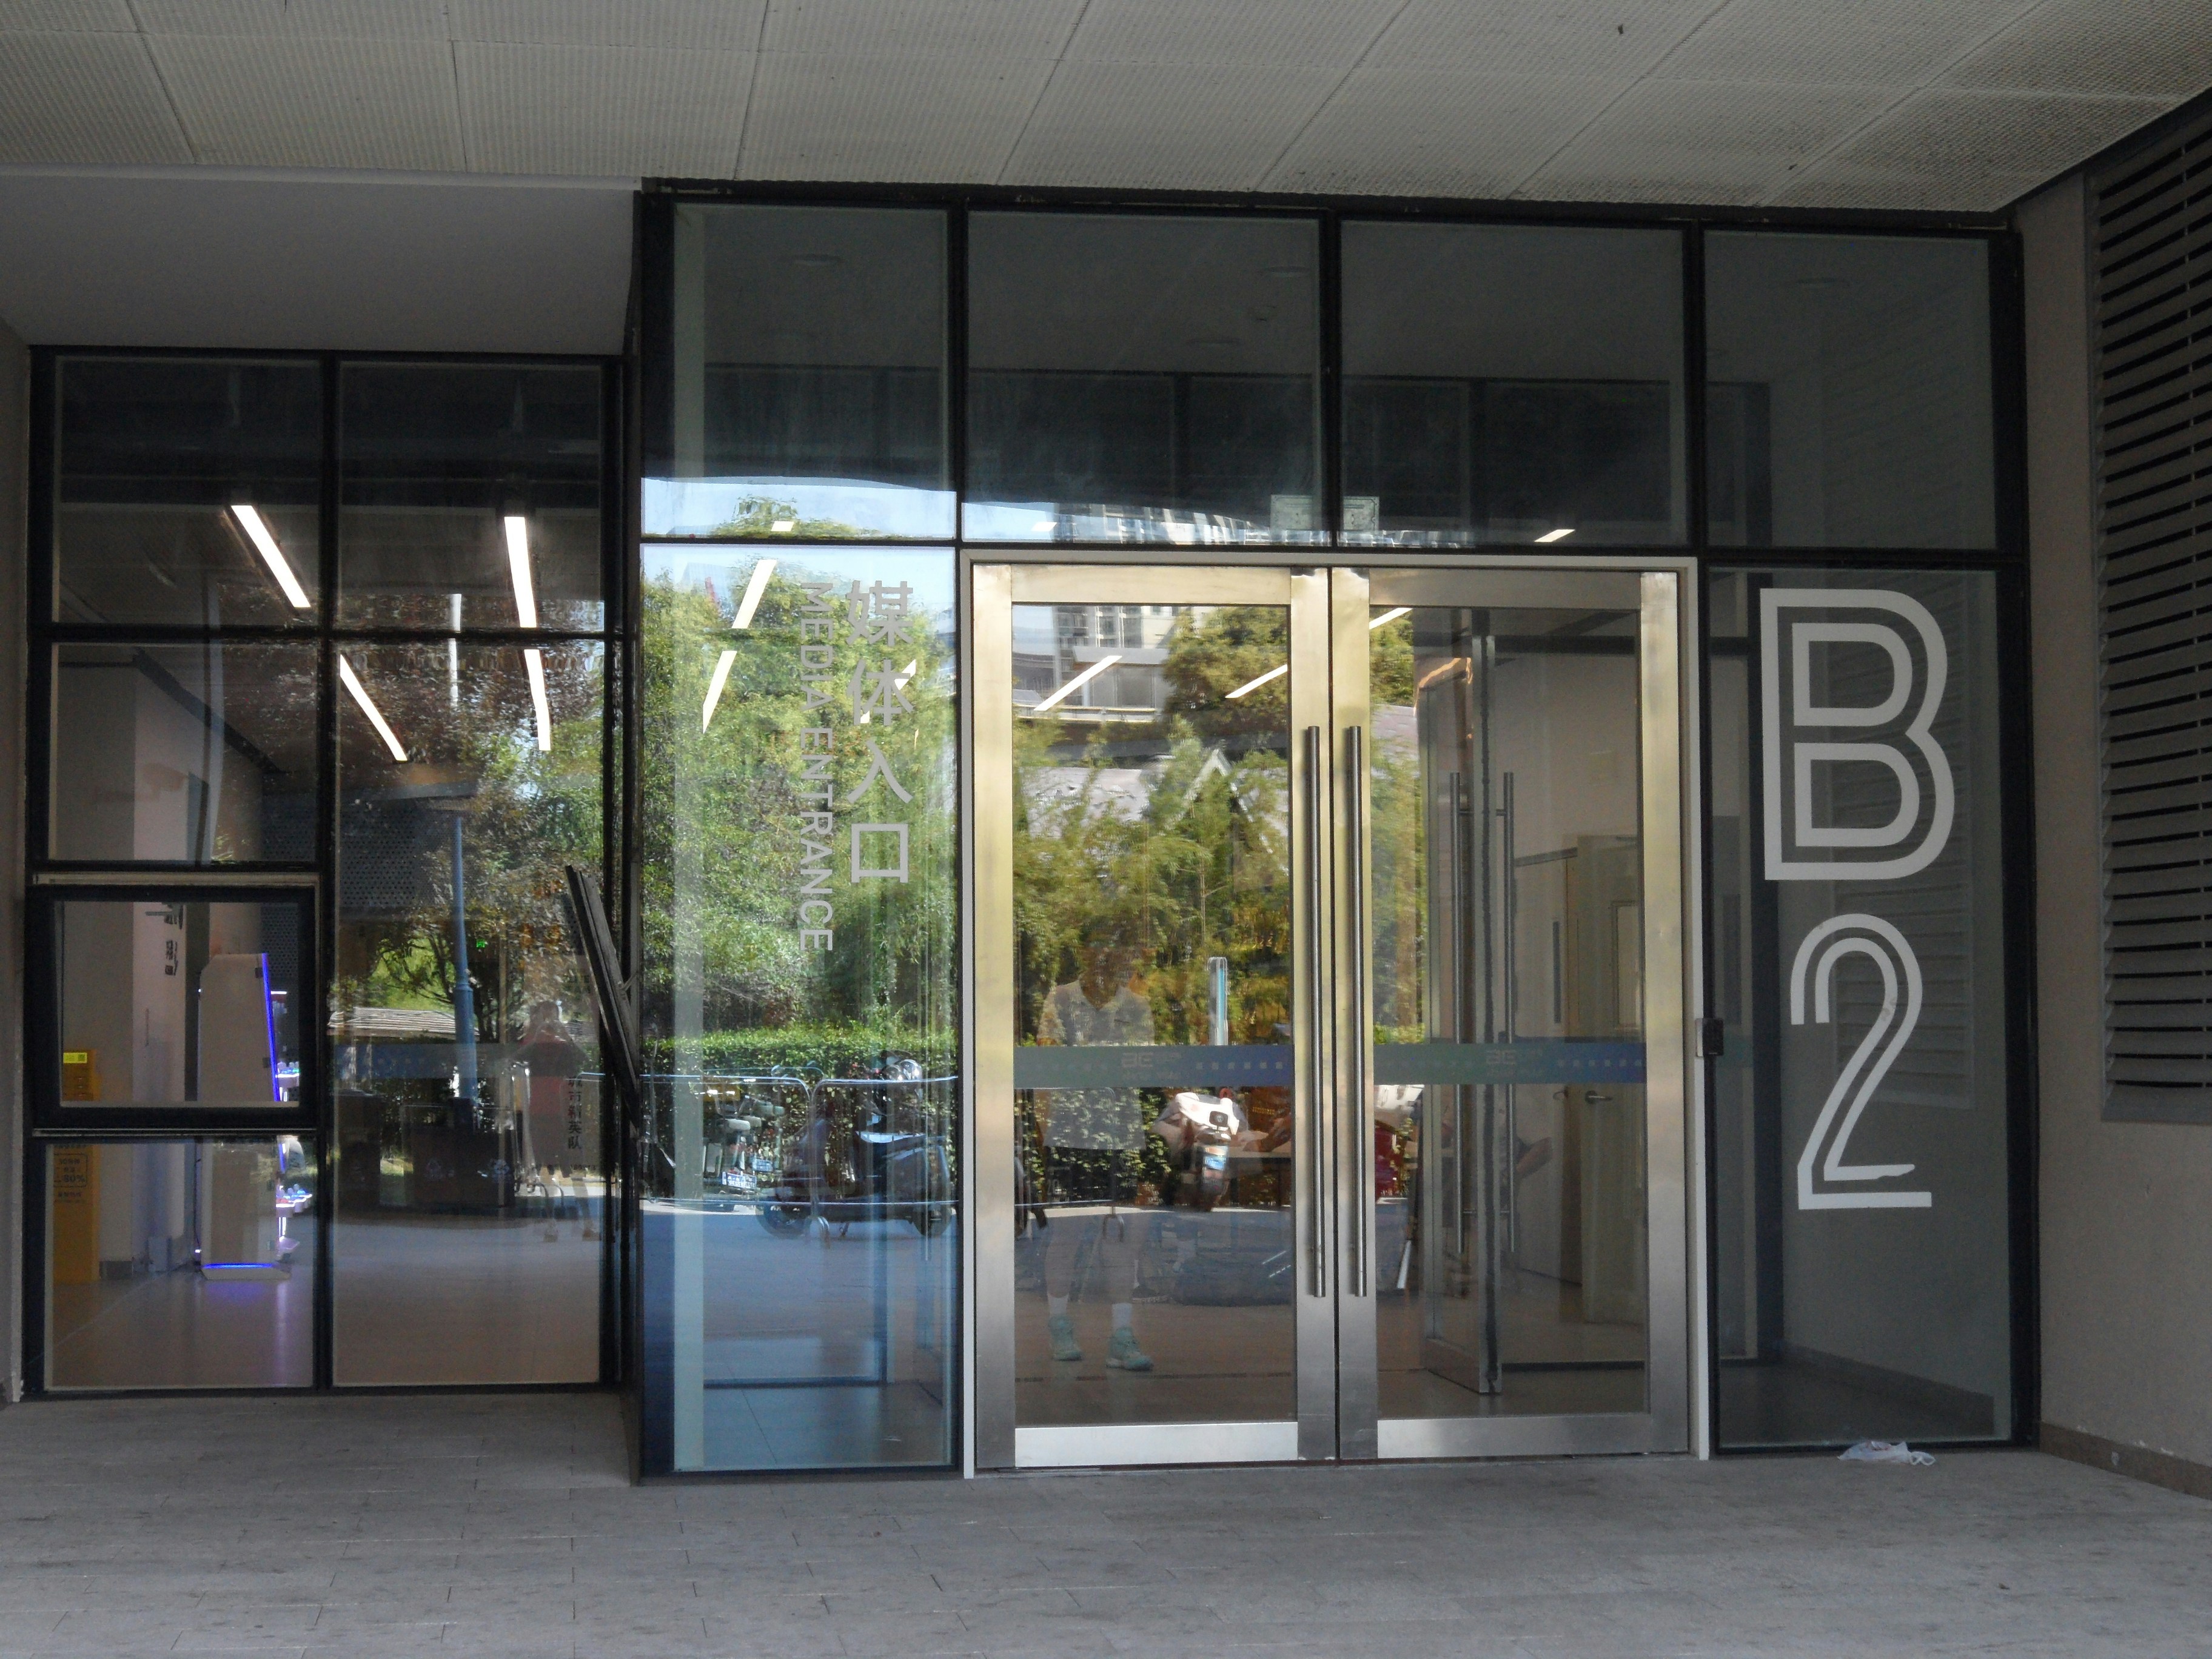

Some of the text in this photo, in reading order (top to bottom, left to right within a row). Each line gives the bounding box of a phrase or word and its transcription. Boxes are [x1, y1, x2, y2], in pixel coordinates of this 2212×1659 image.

[800, 582, 834, 951] MEDIA ENTRANCE
[845, 580, 914, 883] 媒体入口
[1760, 588, 1956, 1210] B2
